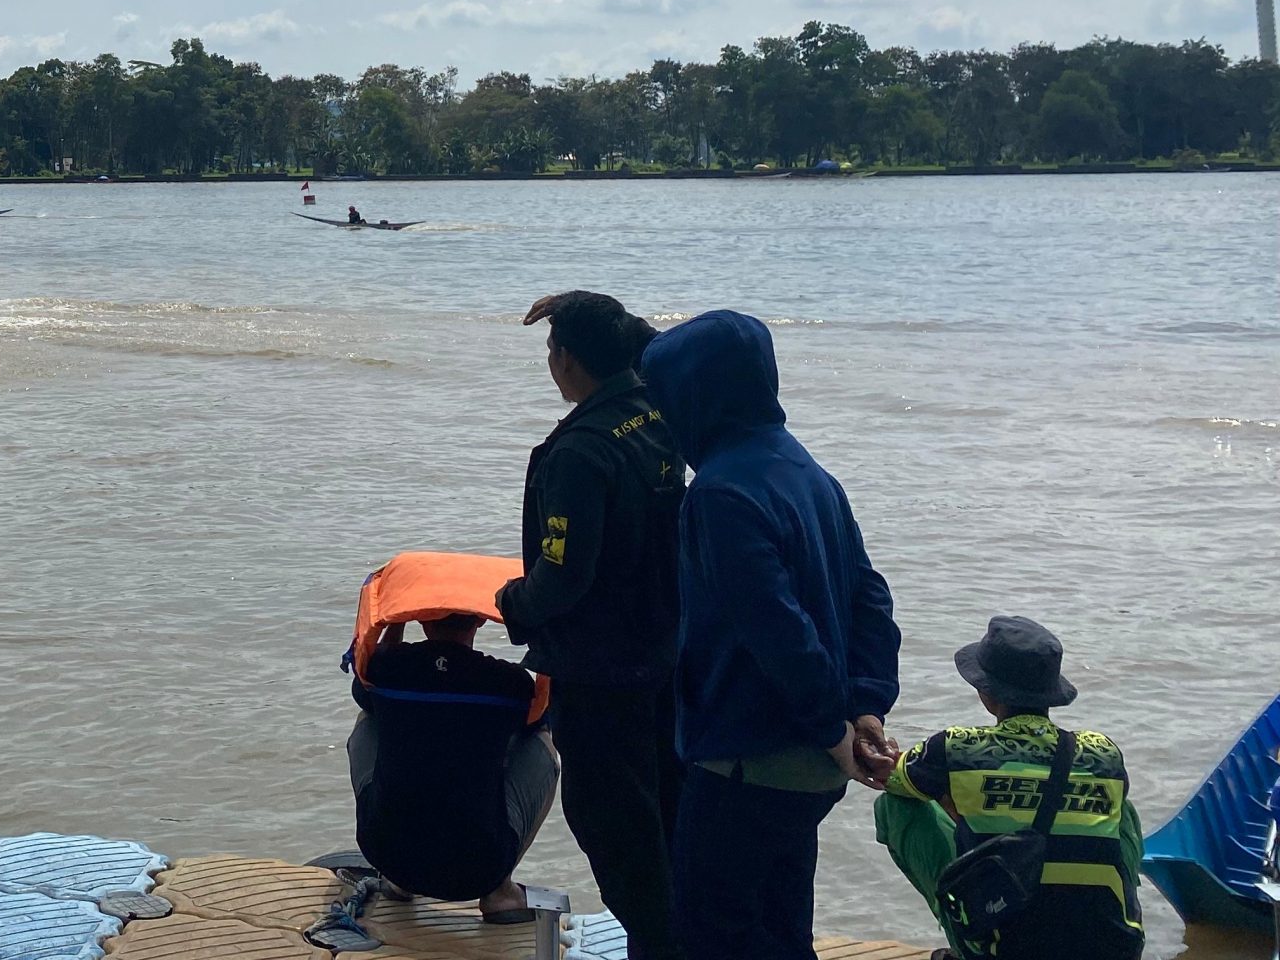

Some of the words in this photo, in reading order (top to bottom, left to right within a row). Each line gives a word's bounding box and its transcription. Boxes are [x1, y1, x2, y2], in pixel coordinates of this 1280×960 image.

[612, 427, 624, 438] IT
[620, 421, 632, 434] IS
[628, 414, 645, 429] NOT
[980, 775, 1111, 799] BEUA
